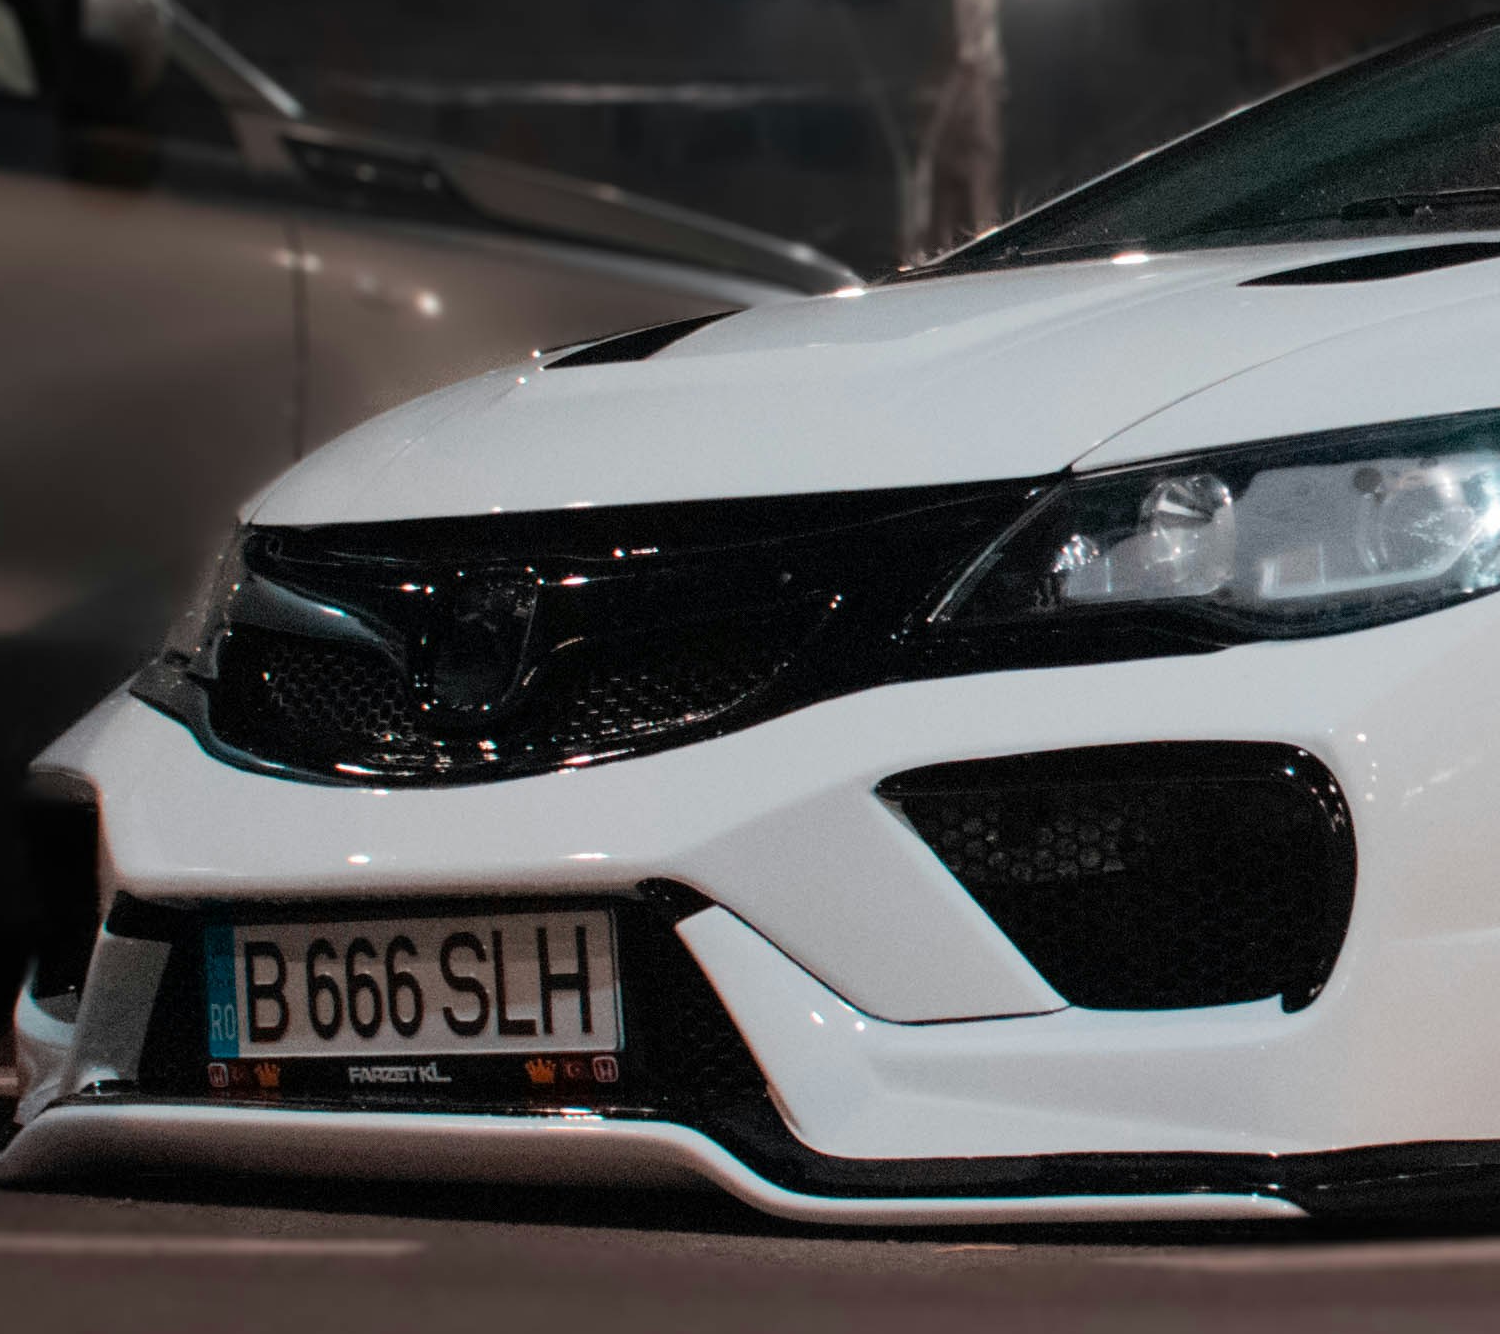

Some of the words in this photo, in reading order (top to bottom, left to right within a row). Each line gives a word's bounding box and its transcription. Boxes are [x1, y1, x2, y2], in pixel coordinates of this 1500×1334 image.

[211, 1003, 238, 1041] RO
[245, 940, 289, 1044] B
[306, 934, 424, 1041] 666
[439, 925, 594, 1037] SLH
